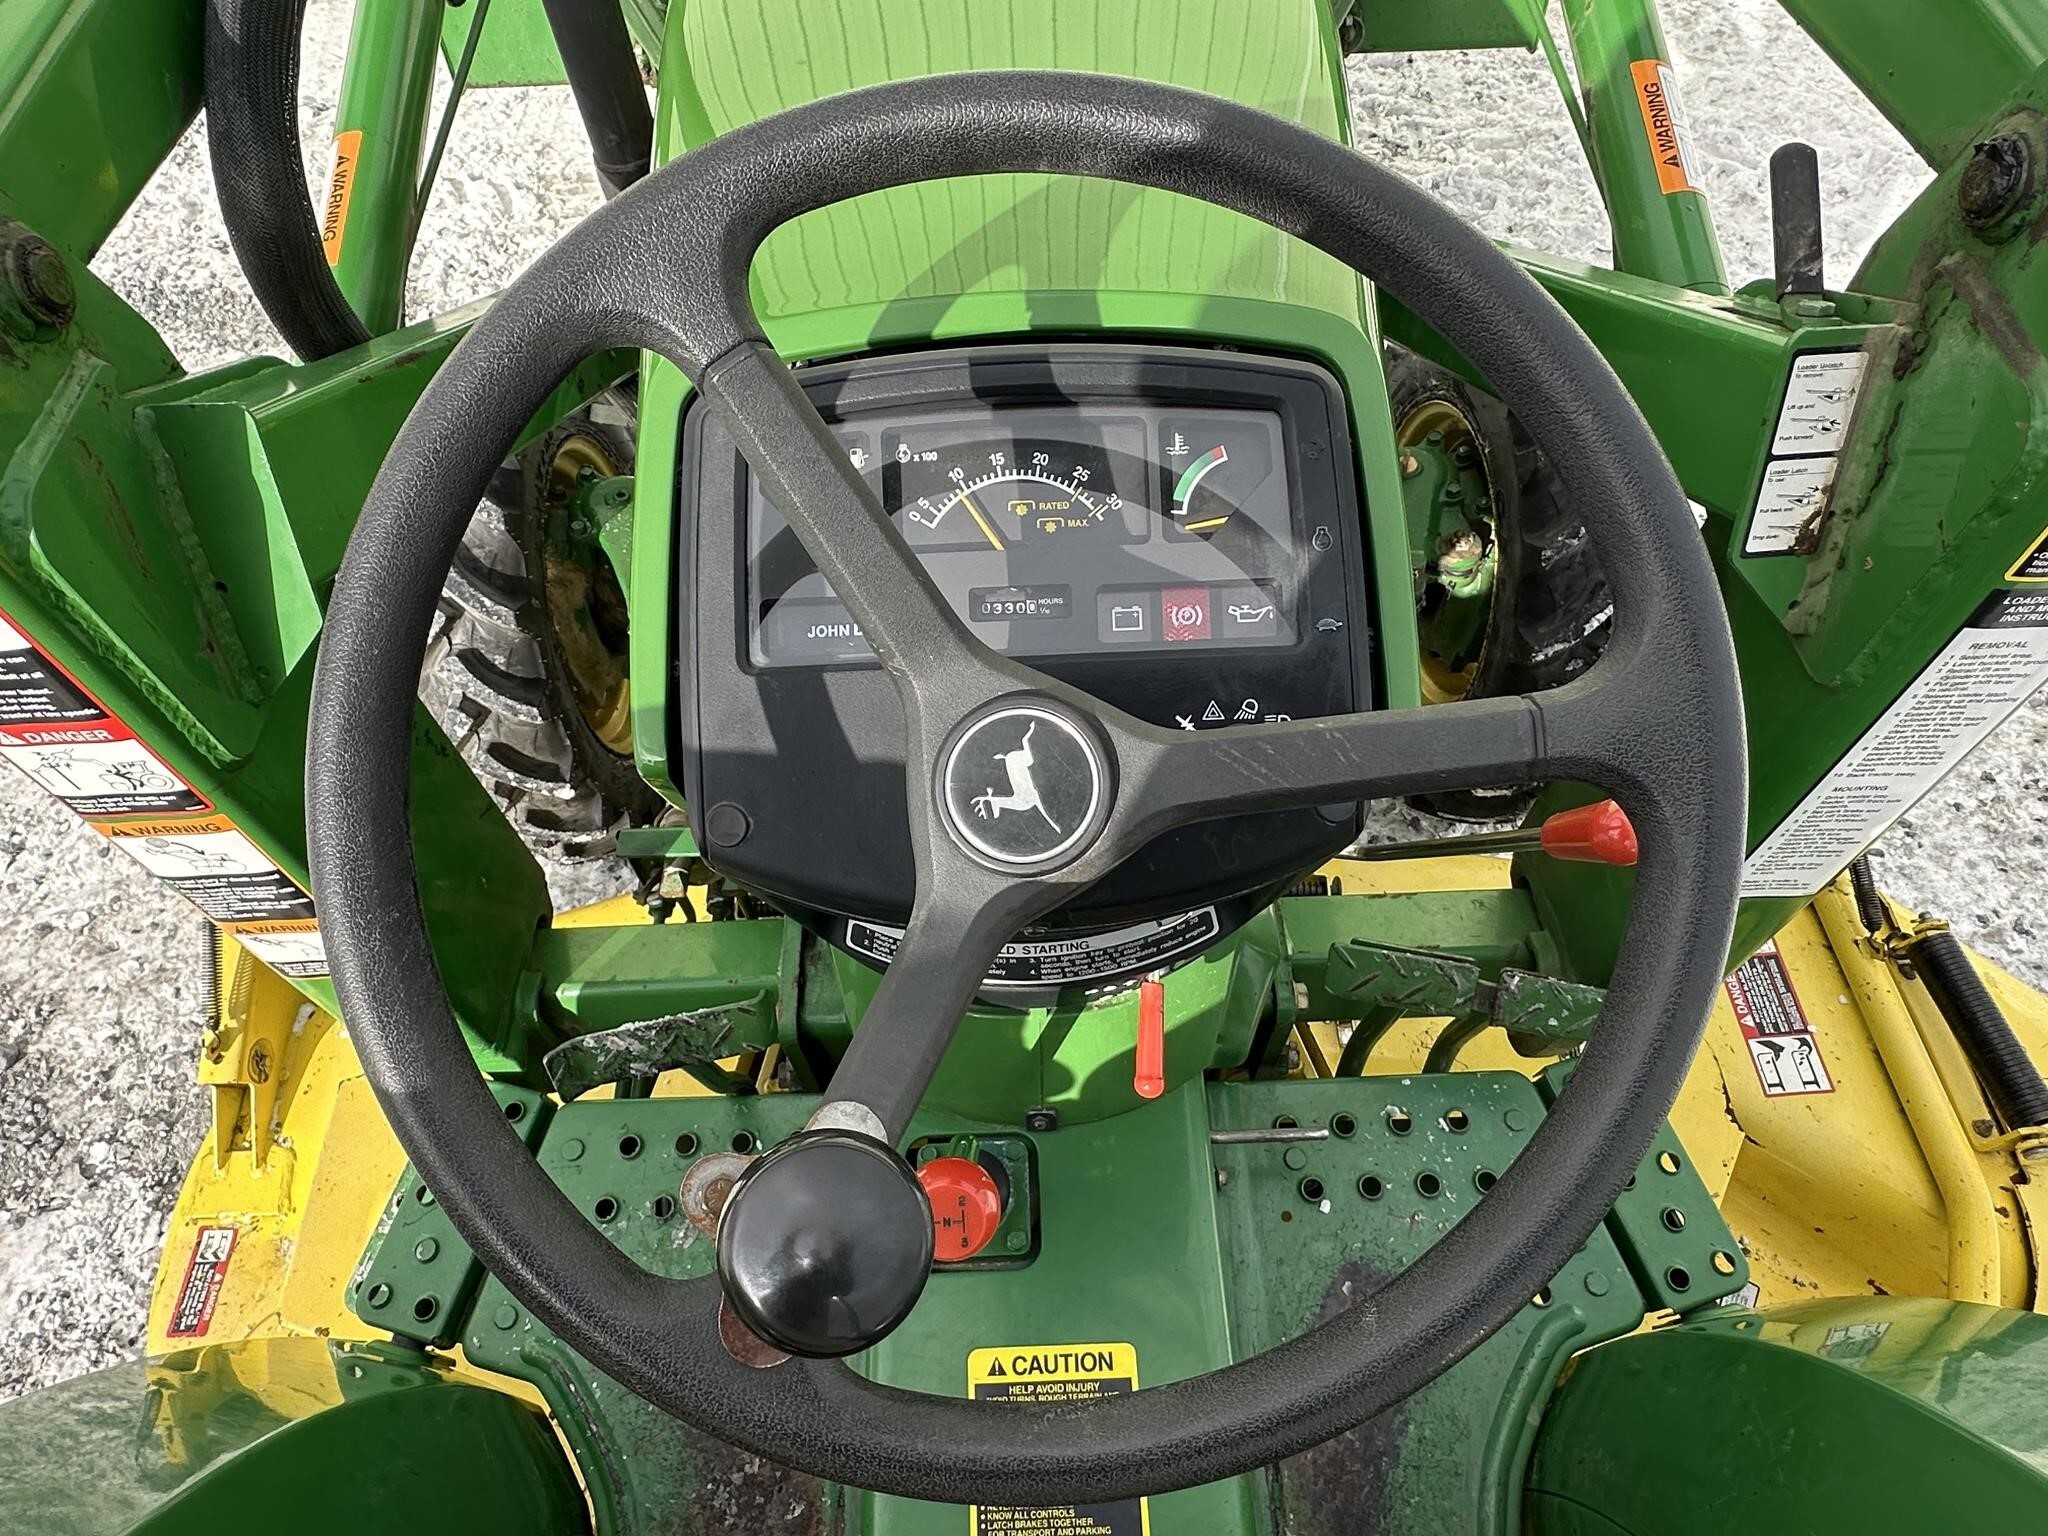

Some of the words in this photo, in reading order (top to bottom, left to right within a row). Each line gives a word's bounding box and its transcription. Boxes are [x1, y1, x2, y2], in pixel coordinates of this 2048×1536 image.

[1643, 82, 1676, 154] WARNING
[322, 169, 349, 242] WARNING
[920, 452, 938, 462] 100
[988, 452, 1005, 466] 15
[1032, 452, 1050, 466] 20
[948, 467, 964, 483] 10
[1072, 465, 1091, 482] 25
[1770, 468, 1790, 476] Loader
[917, 496, 930, 510] 5
[1038, 501, 1070, 511] RATED
[1105, 492, 1124, 512] 30
[908, 510, 922, 522] 0
[1068, 519, 1090, 528] MAX.
[2003, 596, 2048, 604] LOADE
[2004, 606, 2036, 614] AND
[808, 624, 850, 638] JOHN
[1968, 640, 2028, 650] REMOVAL
[22, 729, 115, 743] DANGER
[131, 822, 222, 836] WARNING
[252, 924, 319, 933] WARNIN
[1022, 940, 1090, 955] STARTING
[1060, 953, 1087, 962] ignition
[1148, 928, 1174, 942] position
[1064, 964, 1089, 973] engine
[1160, 936, 1184, 950] reduce
[1185, 925, 1207, 939] engine
[1120, 958, 1138, 967] RPM
[1726, 972, 1749, 1014] DANGE
[958, 1196, 967, 1206] 2
[942, 1216, 952, 1228] N
[1011, 1351, 1114, 1376] CAUTION
[1008, 1384, 1034, 1395] HELP
[1036, 1382, 1064, 1394] AVOID
[1066, 1382, 1100, 1393] INJURY
[987, 1511, 1013, 1521] KNOW
[1014, 1510, 1030, 1520] ALL
[1030, 1509, 1076, 1519] CONTROLS
[987, 1520, 1014, 1530] LATCH
[1014, 1519, 1048, 1528] BRAKES
[1050, 1518, 1094, 1528] TOGETHER
[1006, 1528, 1056, 1536] TRANSPORT
[1057, 1528, 1075, 1536] AND
[1076, 1526, 1112, 1536] PARKING
